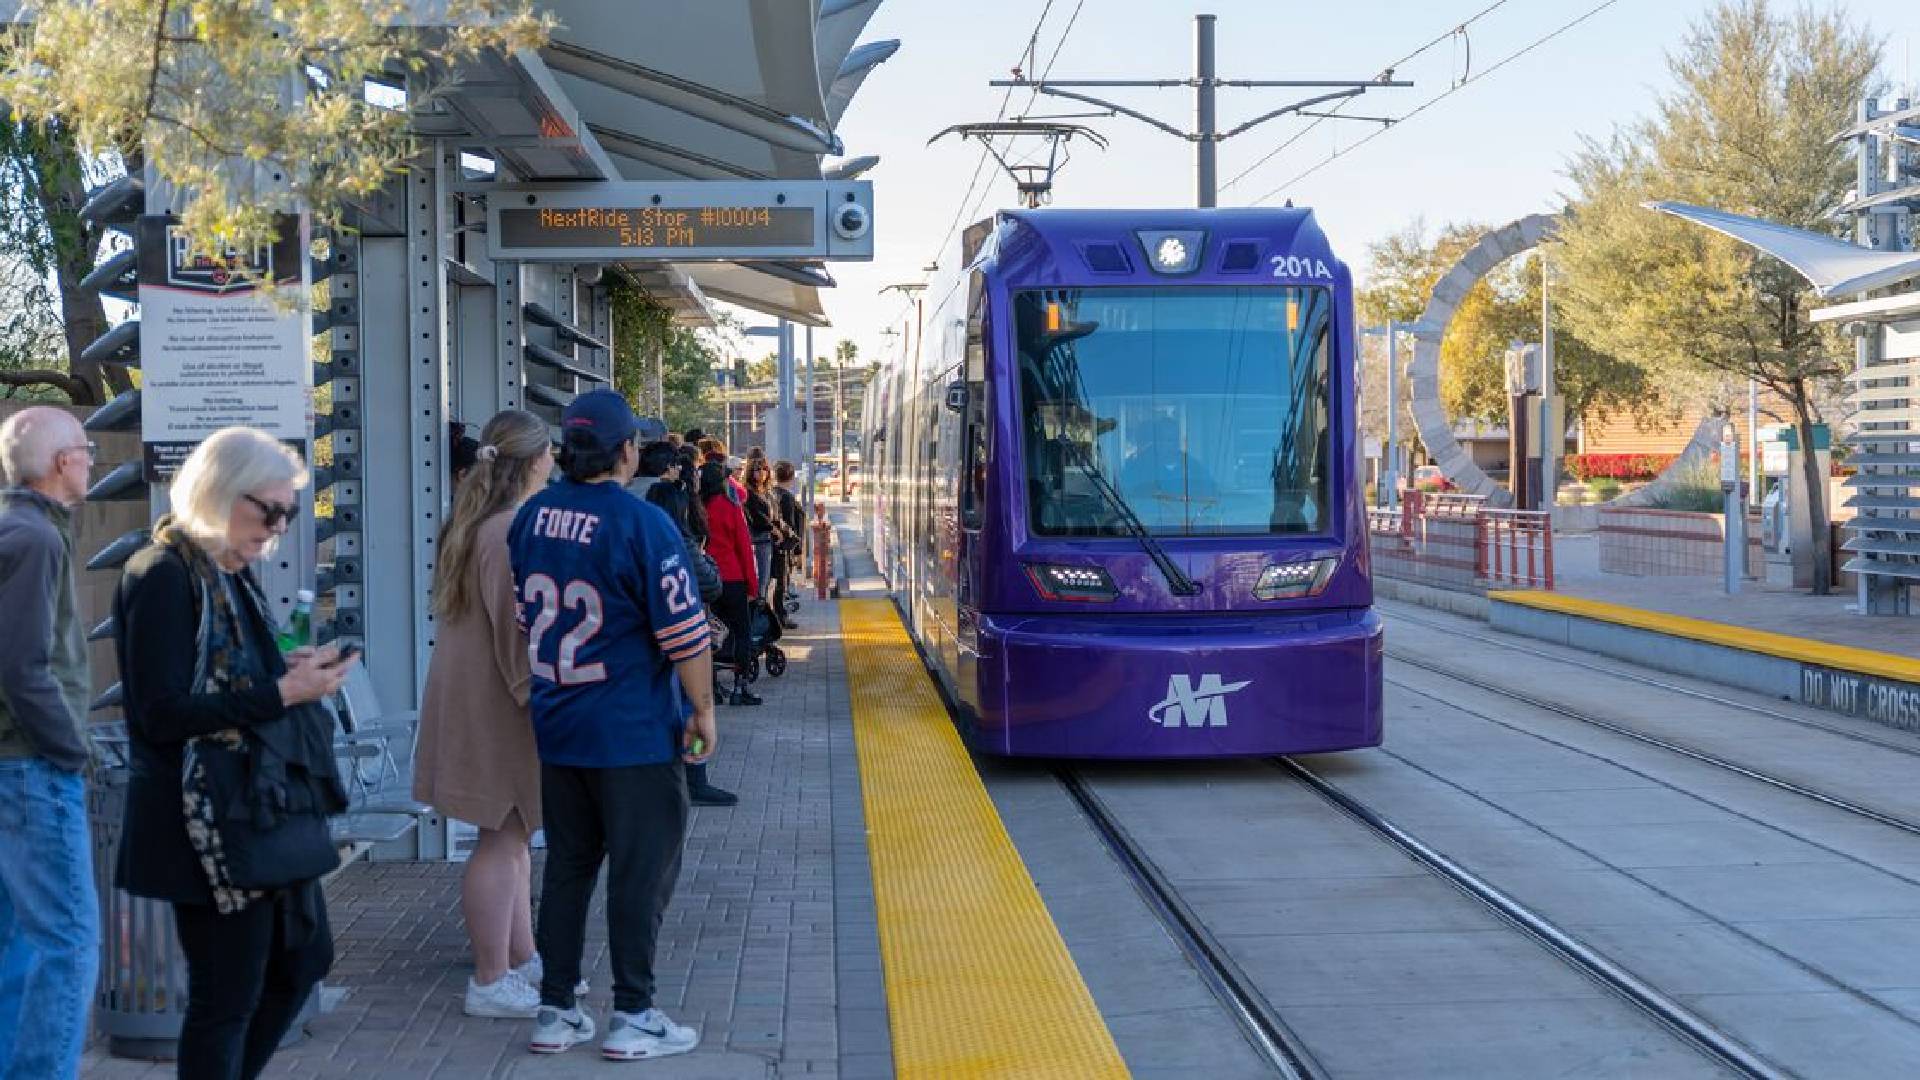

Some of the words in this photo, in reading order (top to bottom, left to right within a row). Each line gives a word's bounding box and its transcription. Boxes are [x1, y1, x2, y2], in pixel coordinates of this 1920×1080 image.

[540, 208, 628, 227] NextRide
[642, 207, 688, 227] Stop
[700, 206, 769, 226] #10004
[620, 227, 654, 246] 5:13
[667, 227, 694, 246] PM
[1271, 255, 1333, 279] 201A
[533, 506, 599, 545] FORTE
[661, 567, 697, 614] 22
[523, 573, 608, 685] 22
[1804, 669, 1823, 704] DO
[1830, 673, 1859, 713] NOT
